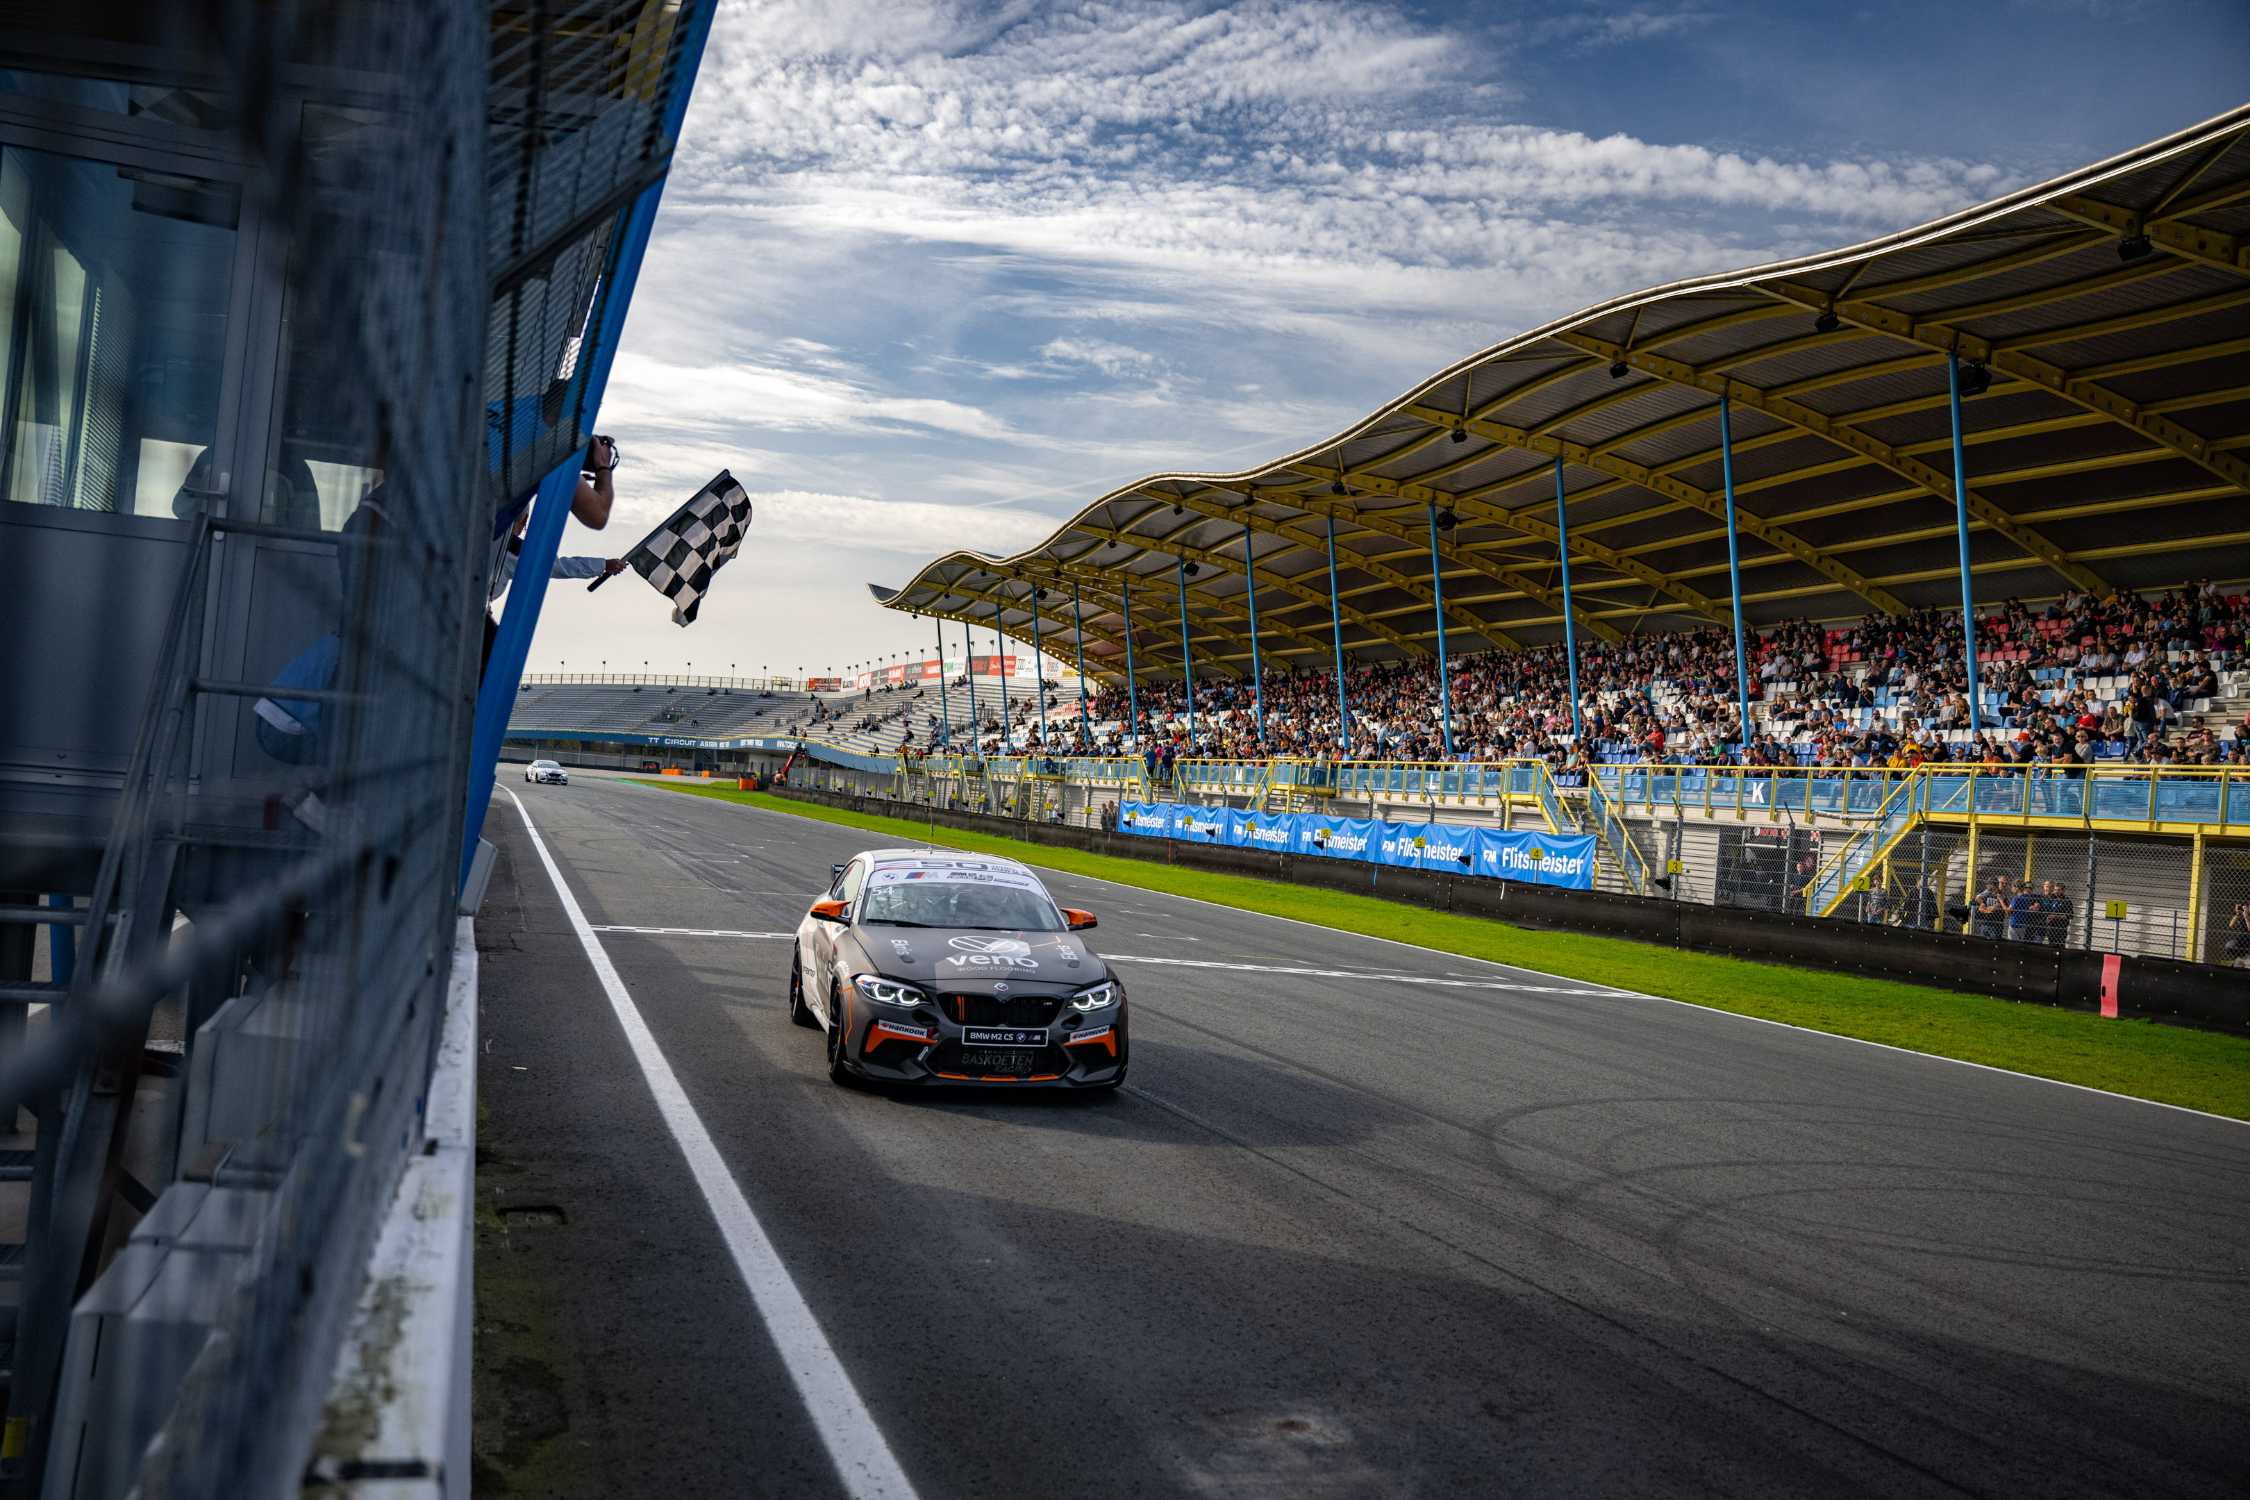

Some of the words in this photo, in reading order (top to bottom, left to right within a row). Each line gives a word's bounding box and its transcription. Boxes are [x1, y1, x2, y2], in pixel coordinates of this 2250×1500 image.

[648, 737, 660, 745] TT
[665, 738, 696, 747] CIRCUIT
[1752, 782, 1765, 803] K
[1671, 862, 1678, 873] 3
[1858, 878, 1865, 890] 2
[945, 953, 1040, 968] veno
[970, 1032, 990, 1040] BMW
[991, 1033, 1003, 1041] M2
[1004, 1033, 1014, 1041] CS
